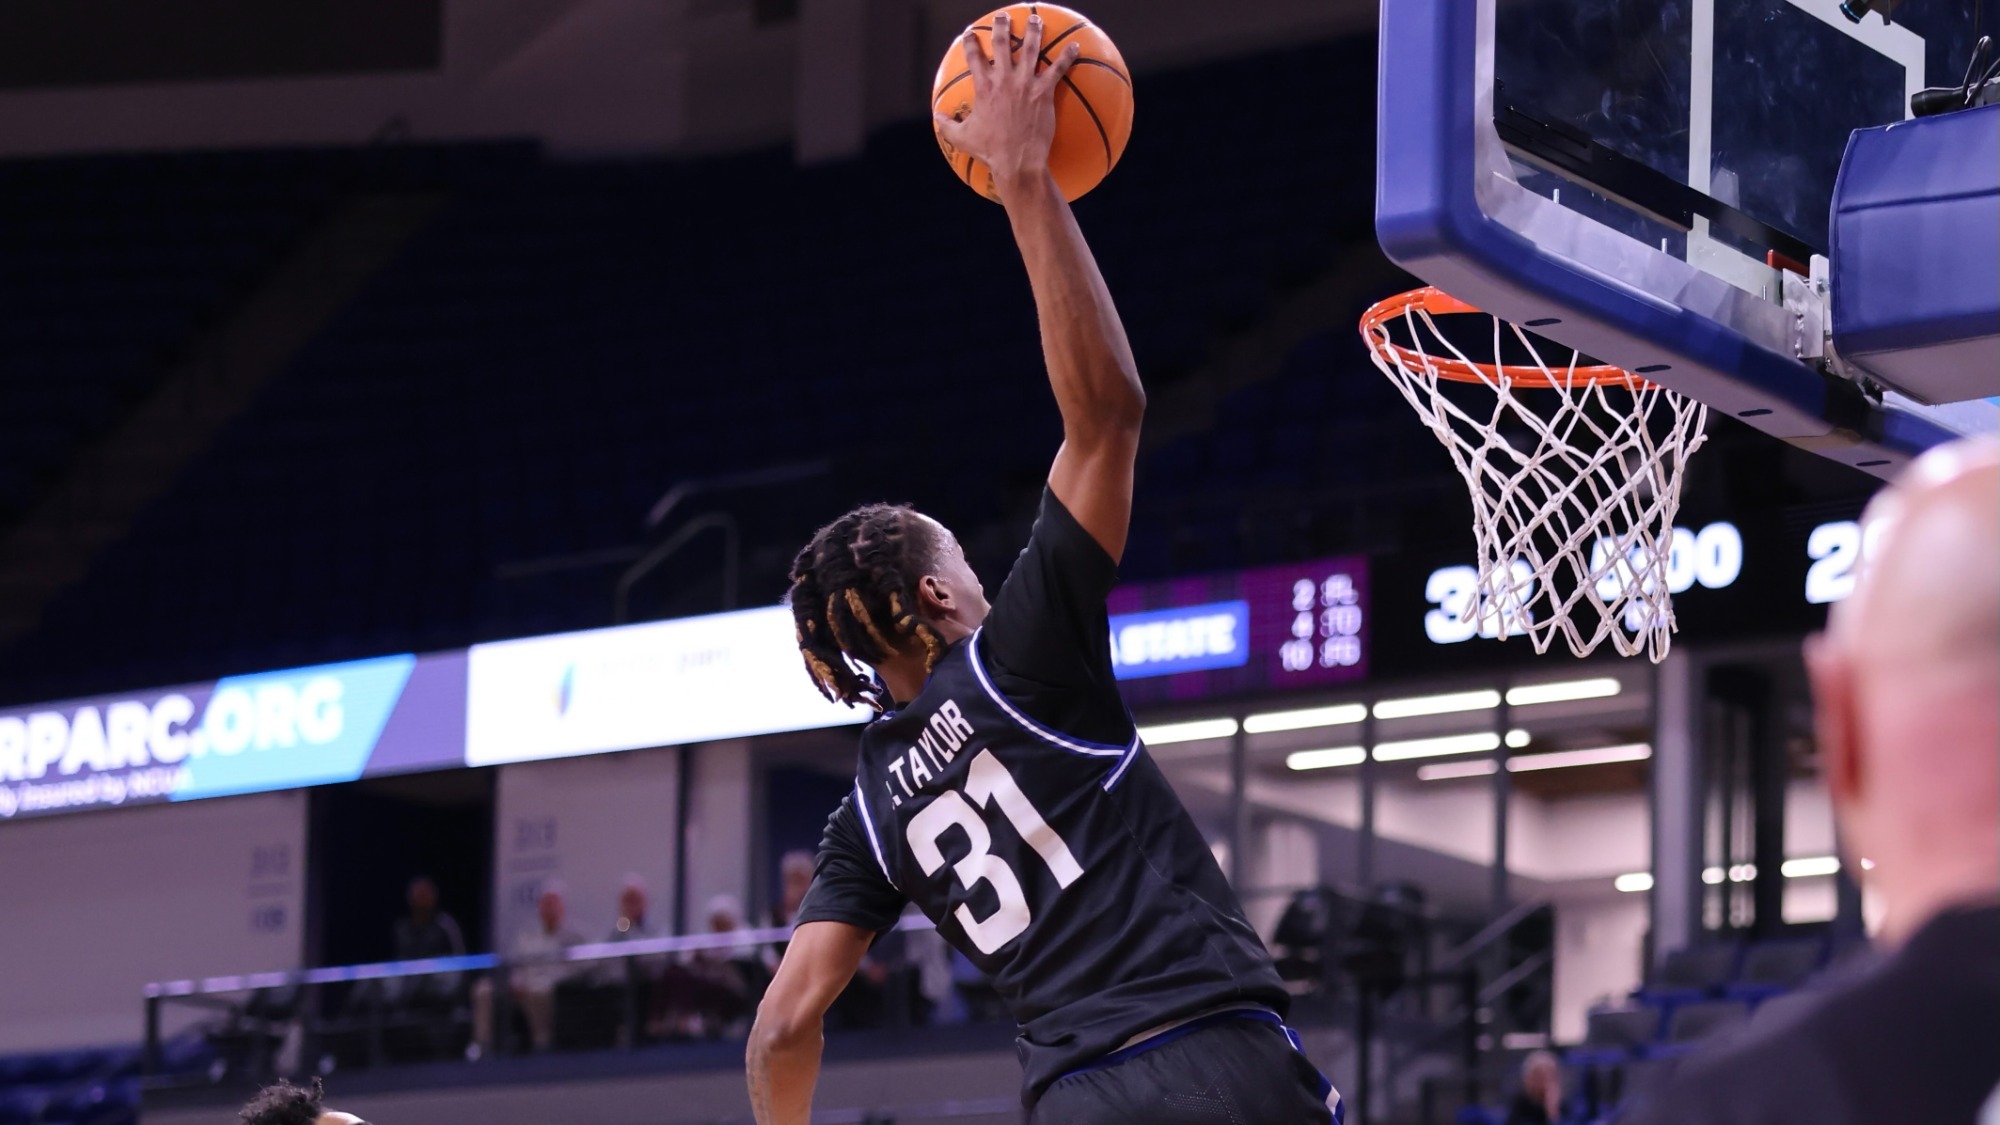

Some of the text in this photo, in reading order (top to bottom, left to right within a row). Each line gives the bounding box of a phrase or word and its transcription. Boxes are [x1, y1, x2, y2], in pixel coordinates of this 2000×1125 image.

[1119, 614, 1236, 666] STATE
[1424, 560, 1534, 644] 32
[906, 748, 1085, 955] 31
